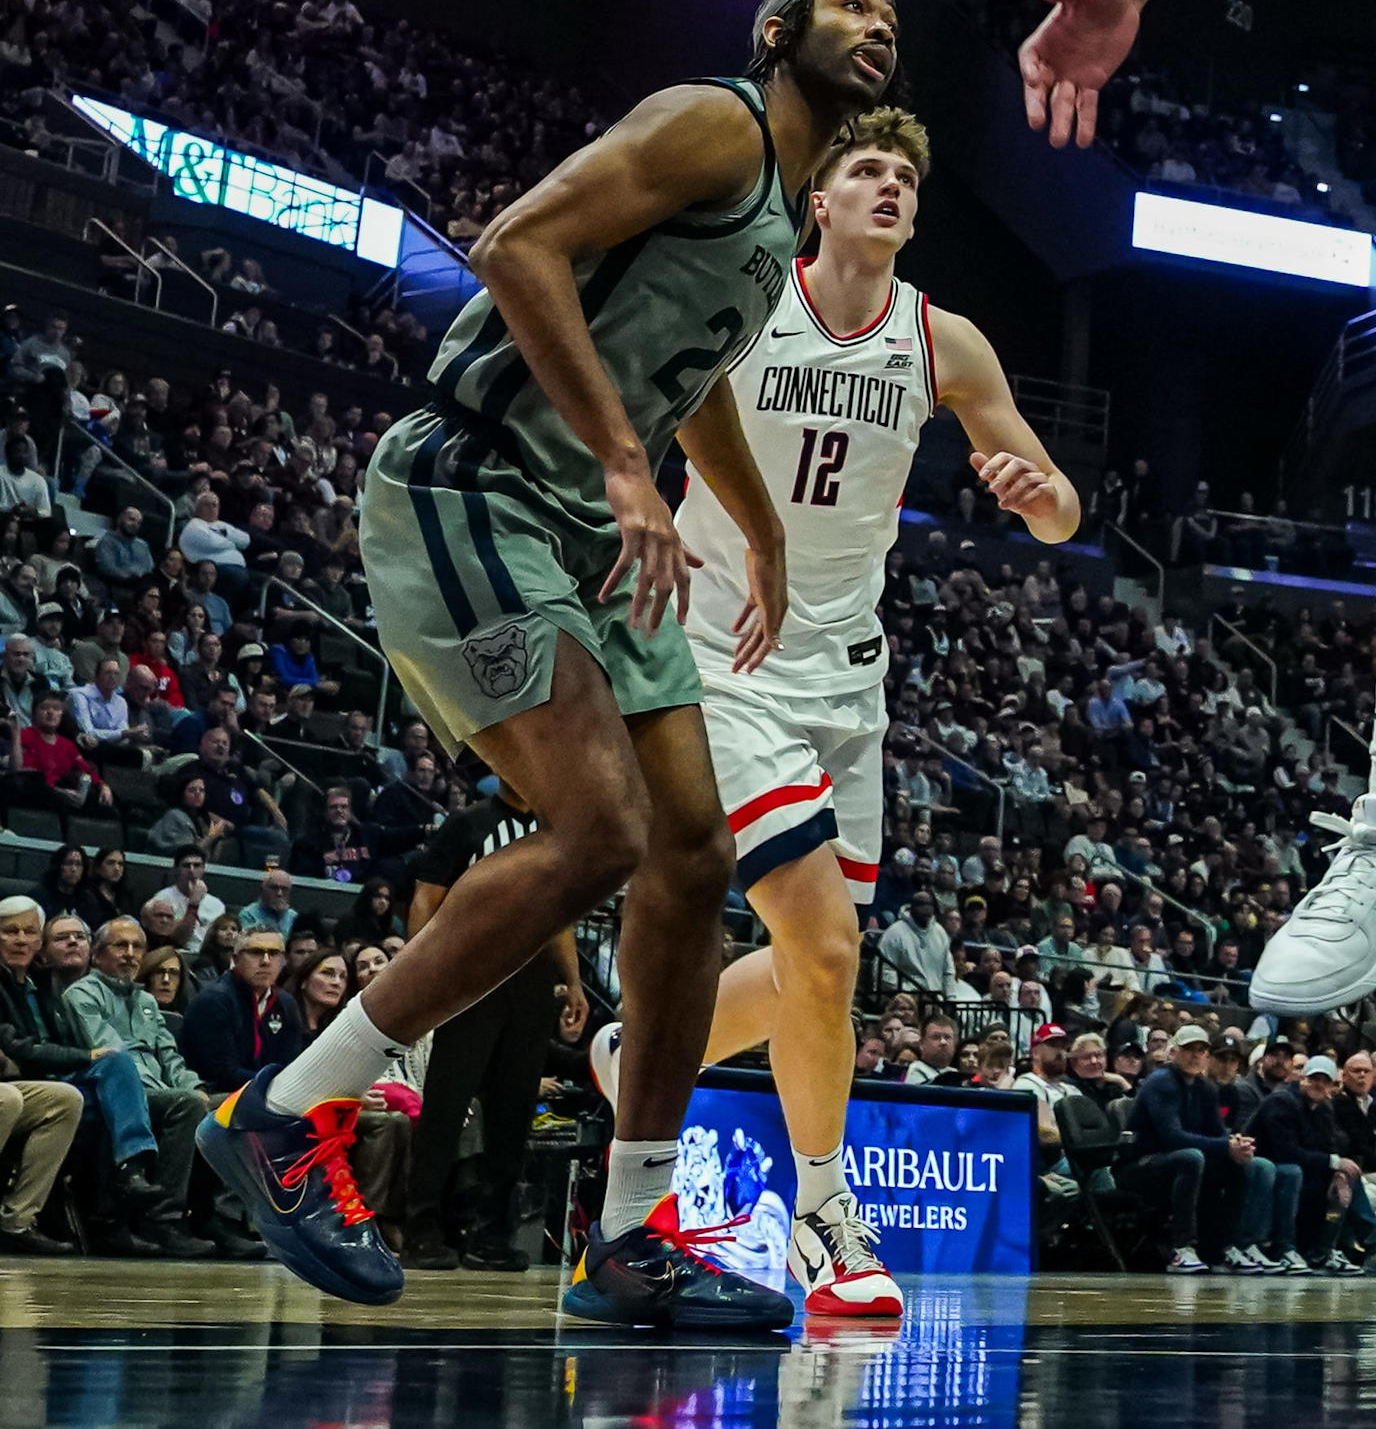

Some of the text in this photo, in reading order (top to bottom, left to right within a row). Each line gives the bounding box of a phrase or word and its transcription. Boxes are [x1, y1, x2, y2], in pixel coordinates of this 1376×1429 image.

[650, 306, 744, 405] 2
[756, 366, 907, 431] CONNECTICUT
[790, 427, 850, 507] 12
[841, 1144, 1005, 1193] ARIBAULT
